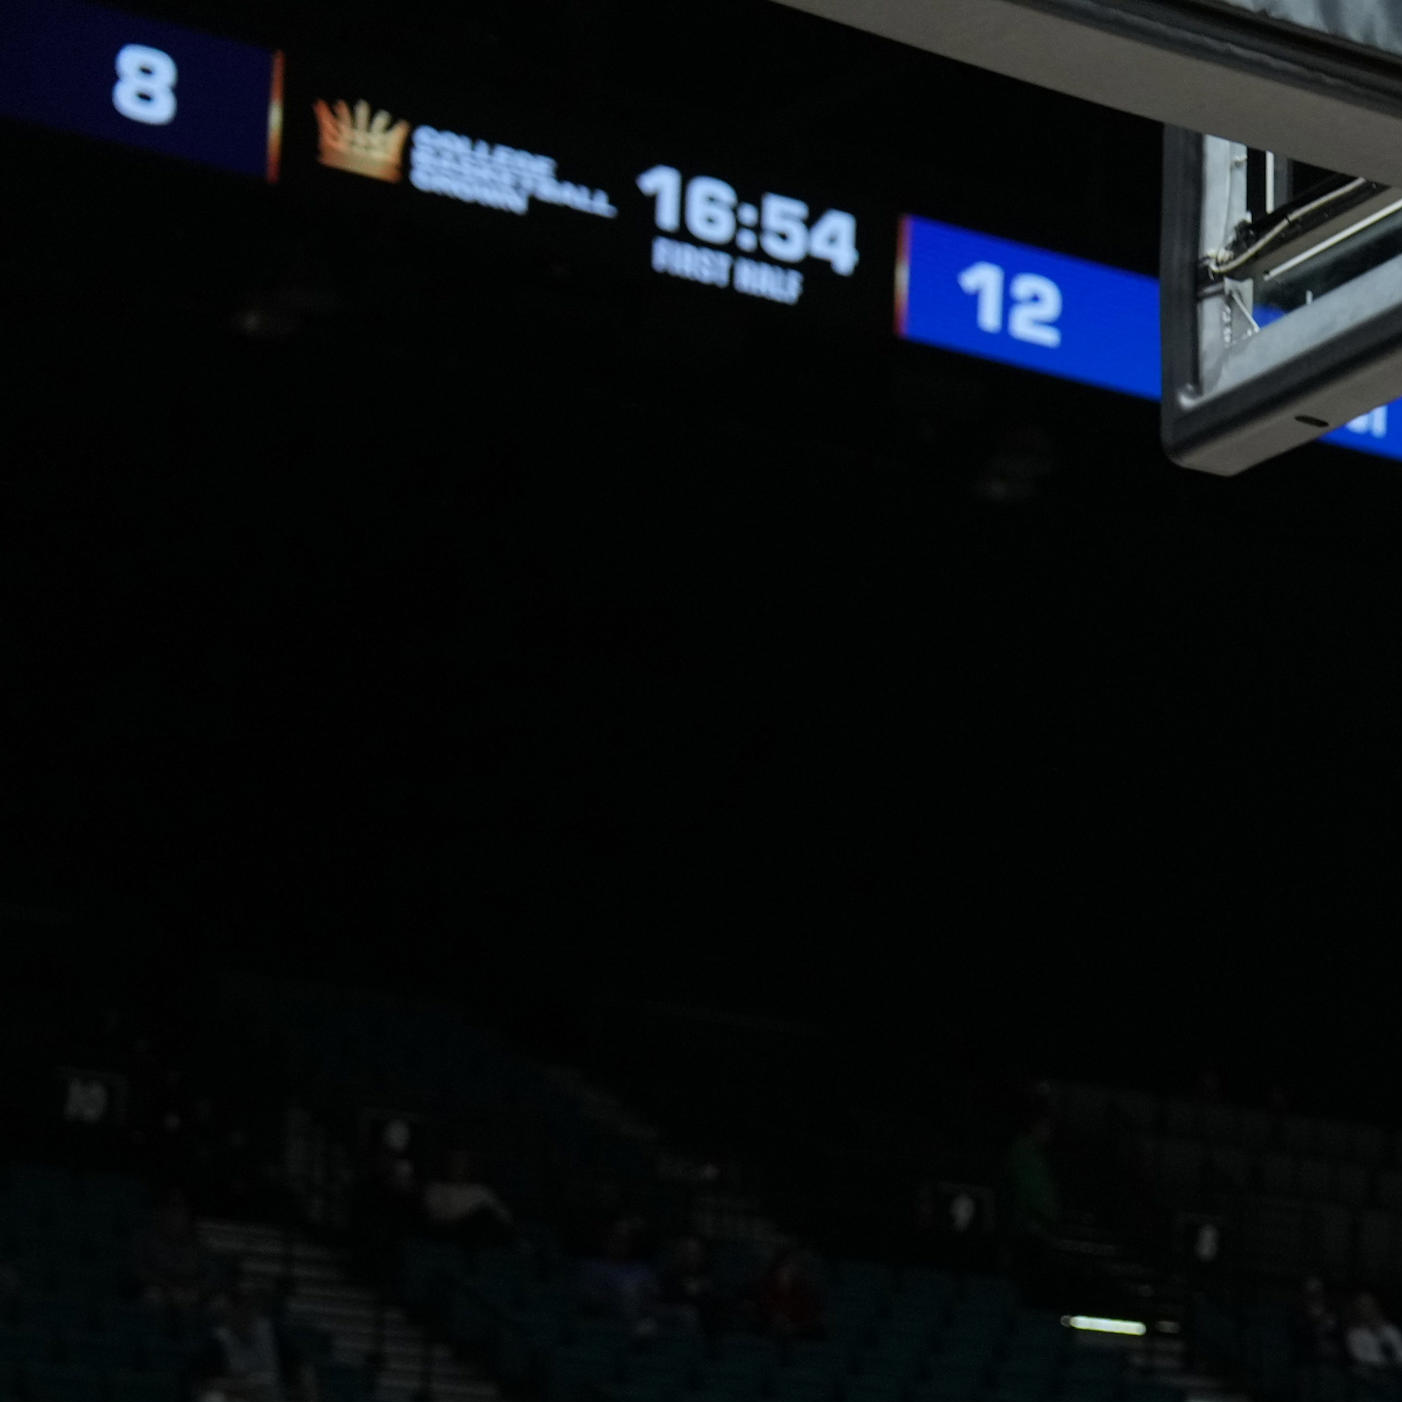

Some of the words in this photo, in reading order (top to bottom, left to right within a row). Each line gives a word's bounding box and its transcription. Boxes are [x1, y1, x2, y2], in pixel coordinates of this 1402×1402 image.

[112, 44, 177, 126] 8
[637, 163, 859, 277] 16:54
[959, 261, 1062, 348] 12
